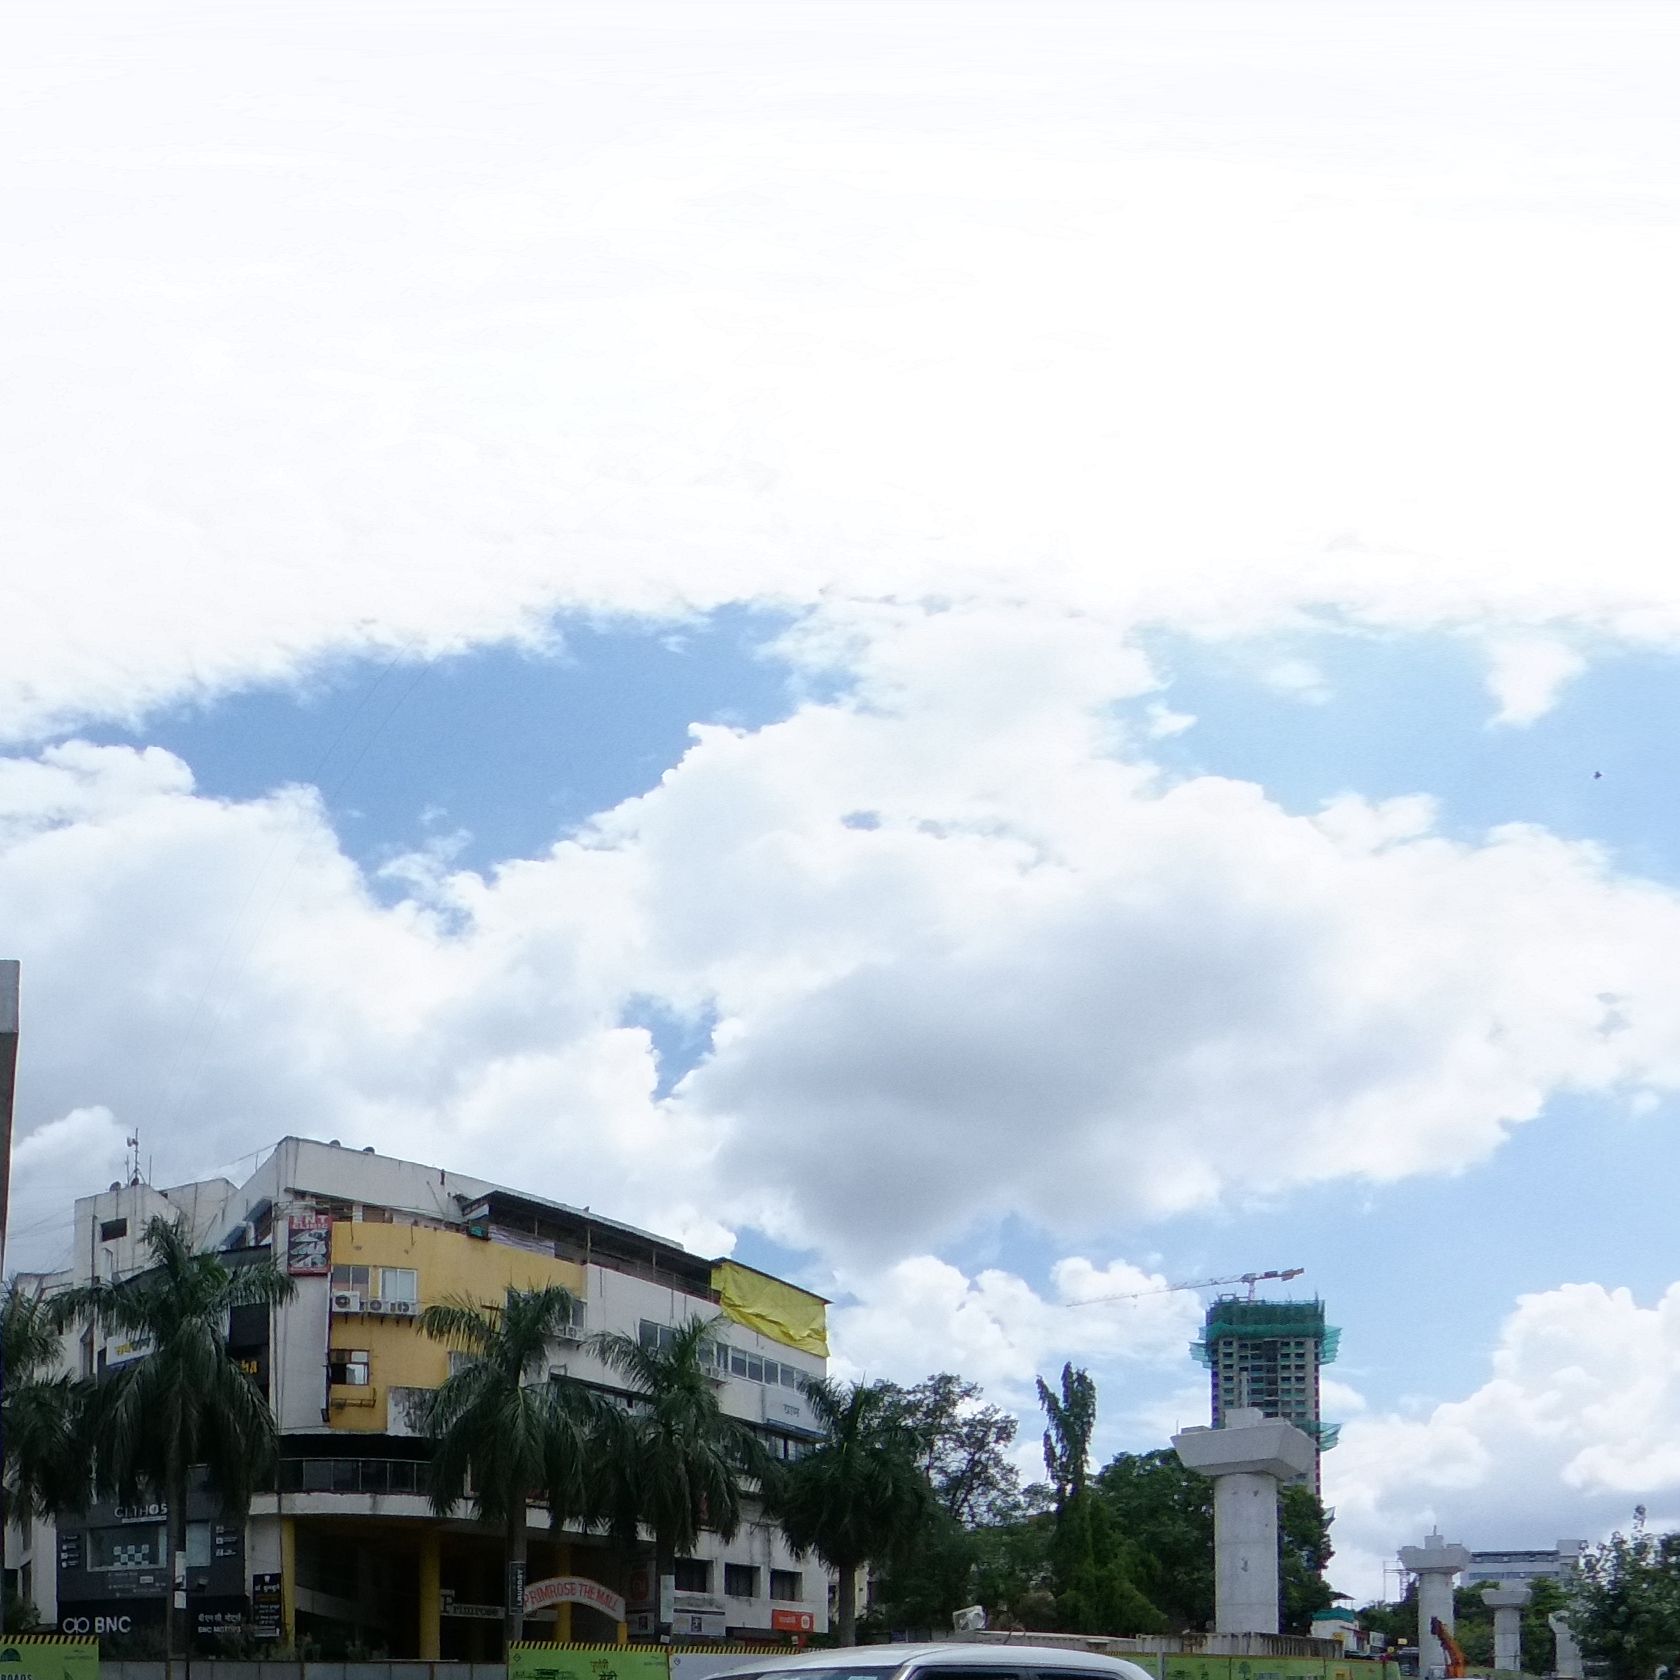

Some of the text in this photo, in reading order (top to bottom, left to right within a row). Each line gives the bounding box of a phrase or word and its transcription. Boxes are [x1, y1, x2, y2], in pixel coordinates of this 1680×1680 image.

[523, 1581, 619, 1613] PRIMROSE THE MALL
[94, 1615, 132, 1634] BNC
